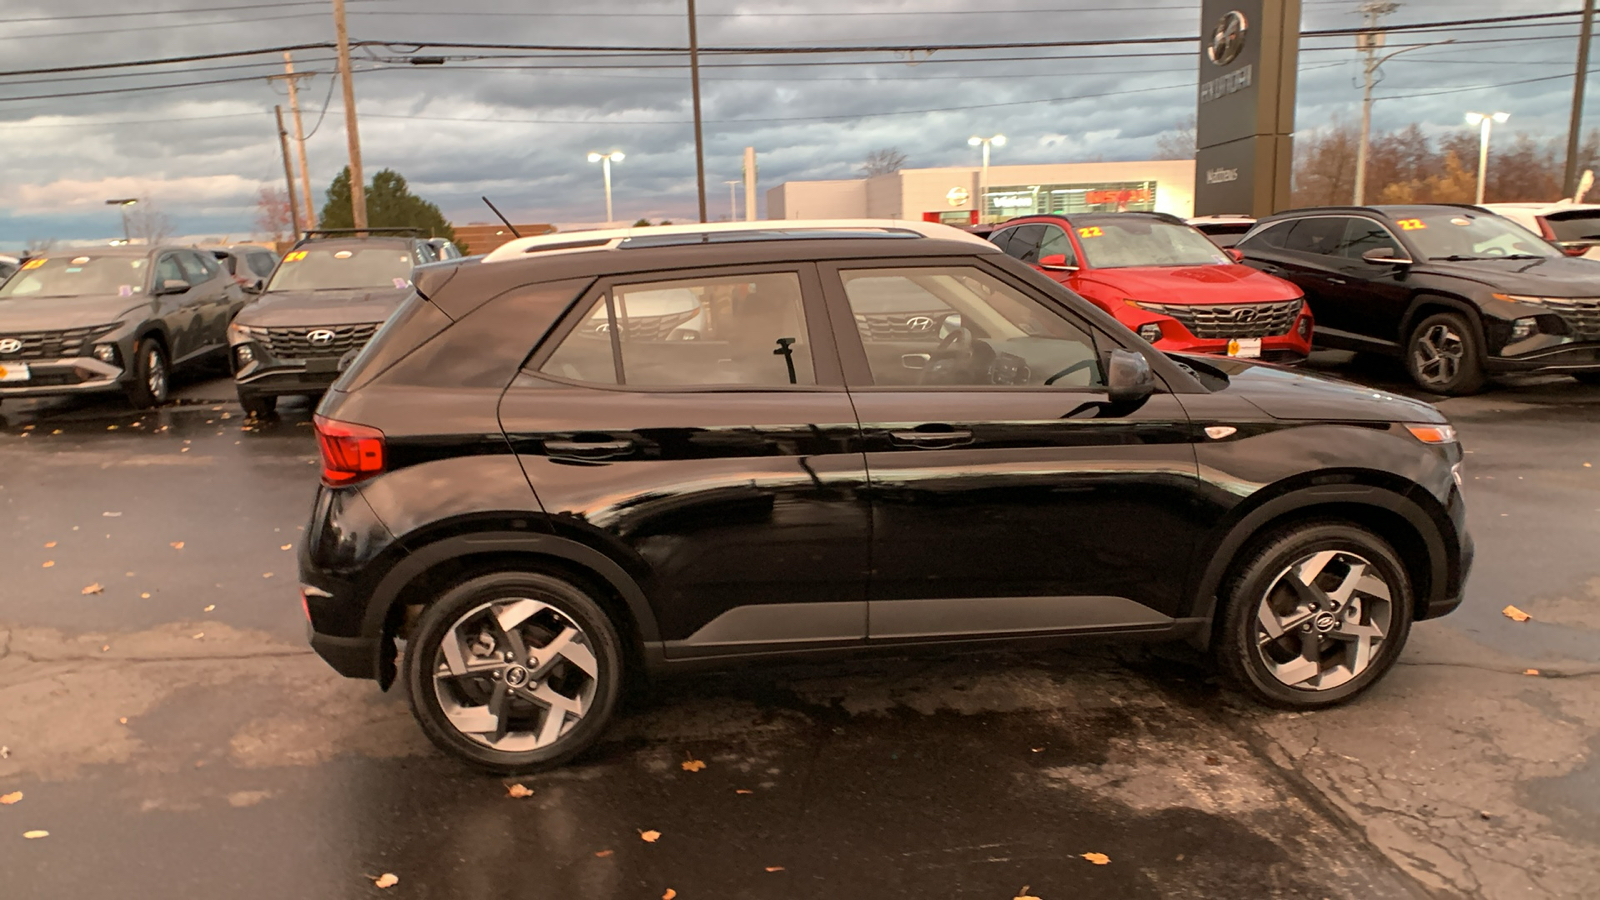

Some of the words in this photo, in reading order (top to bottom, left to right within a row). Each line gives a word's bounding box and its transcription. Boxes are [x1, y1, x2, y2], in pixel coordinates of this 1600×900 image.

[1201, 64, 1252, 104] HYUNDAI
[1397, 218, 1427, 230] 22
[1079, 226, 1103, 238] 22
